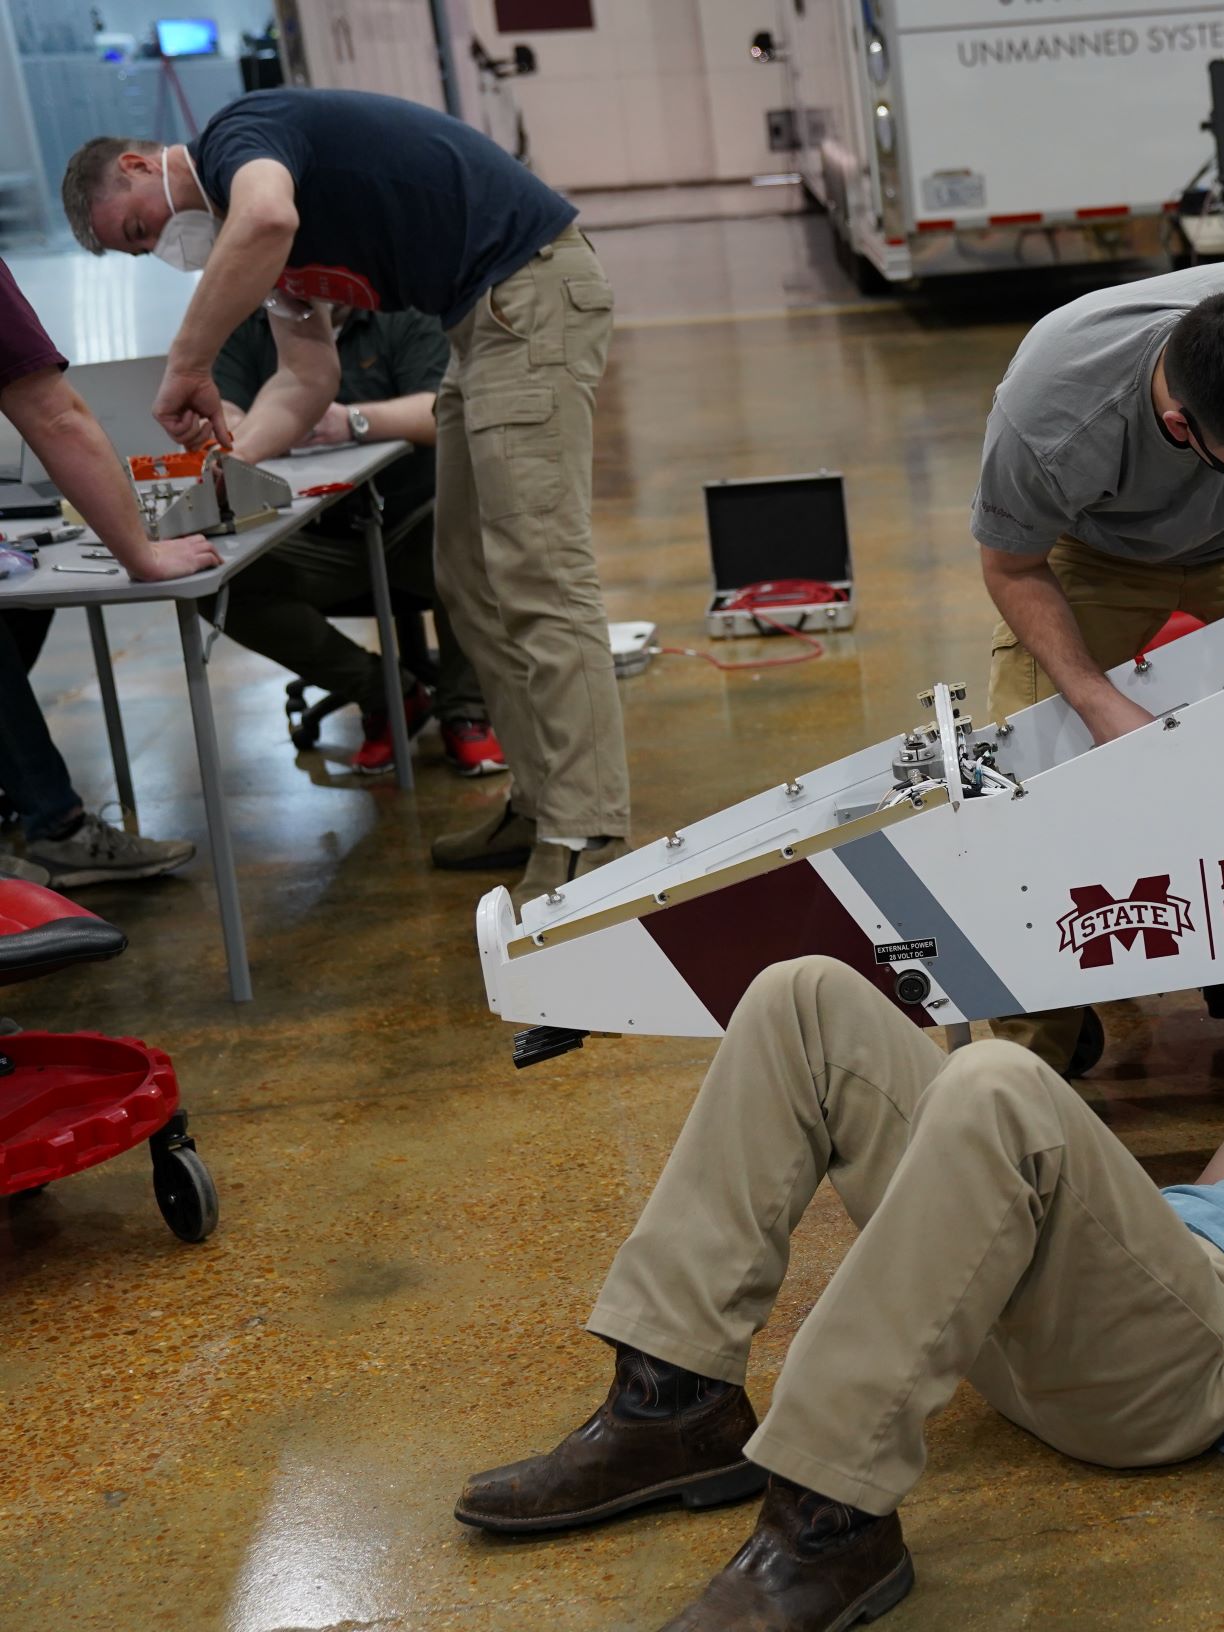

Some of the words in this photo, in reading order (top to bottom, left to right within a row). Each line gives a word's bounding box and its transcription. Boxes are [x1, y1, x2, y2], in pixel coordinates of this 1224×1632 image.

[957, 27, 1138, 68] UNMANNED
[1080, 904, 1169, 938] STATE
[877, 944, 909, 954] EXTERNAL
[910, 941, 934, 949] POWER
[897, 951, 913, 959] VOLT
